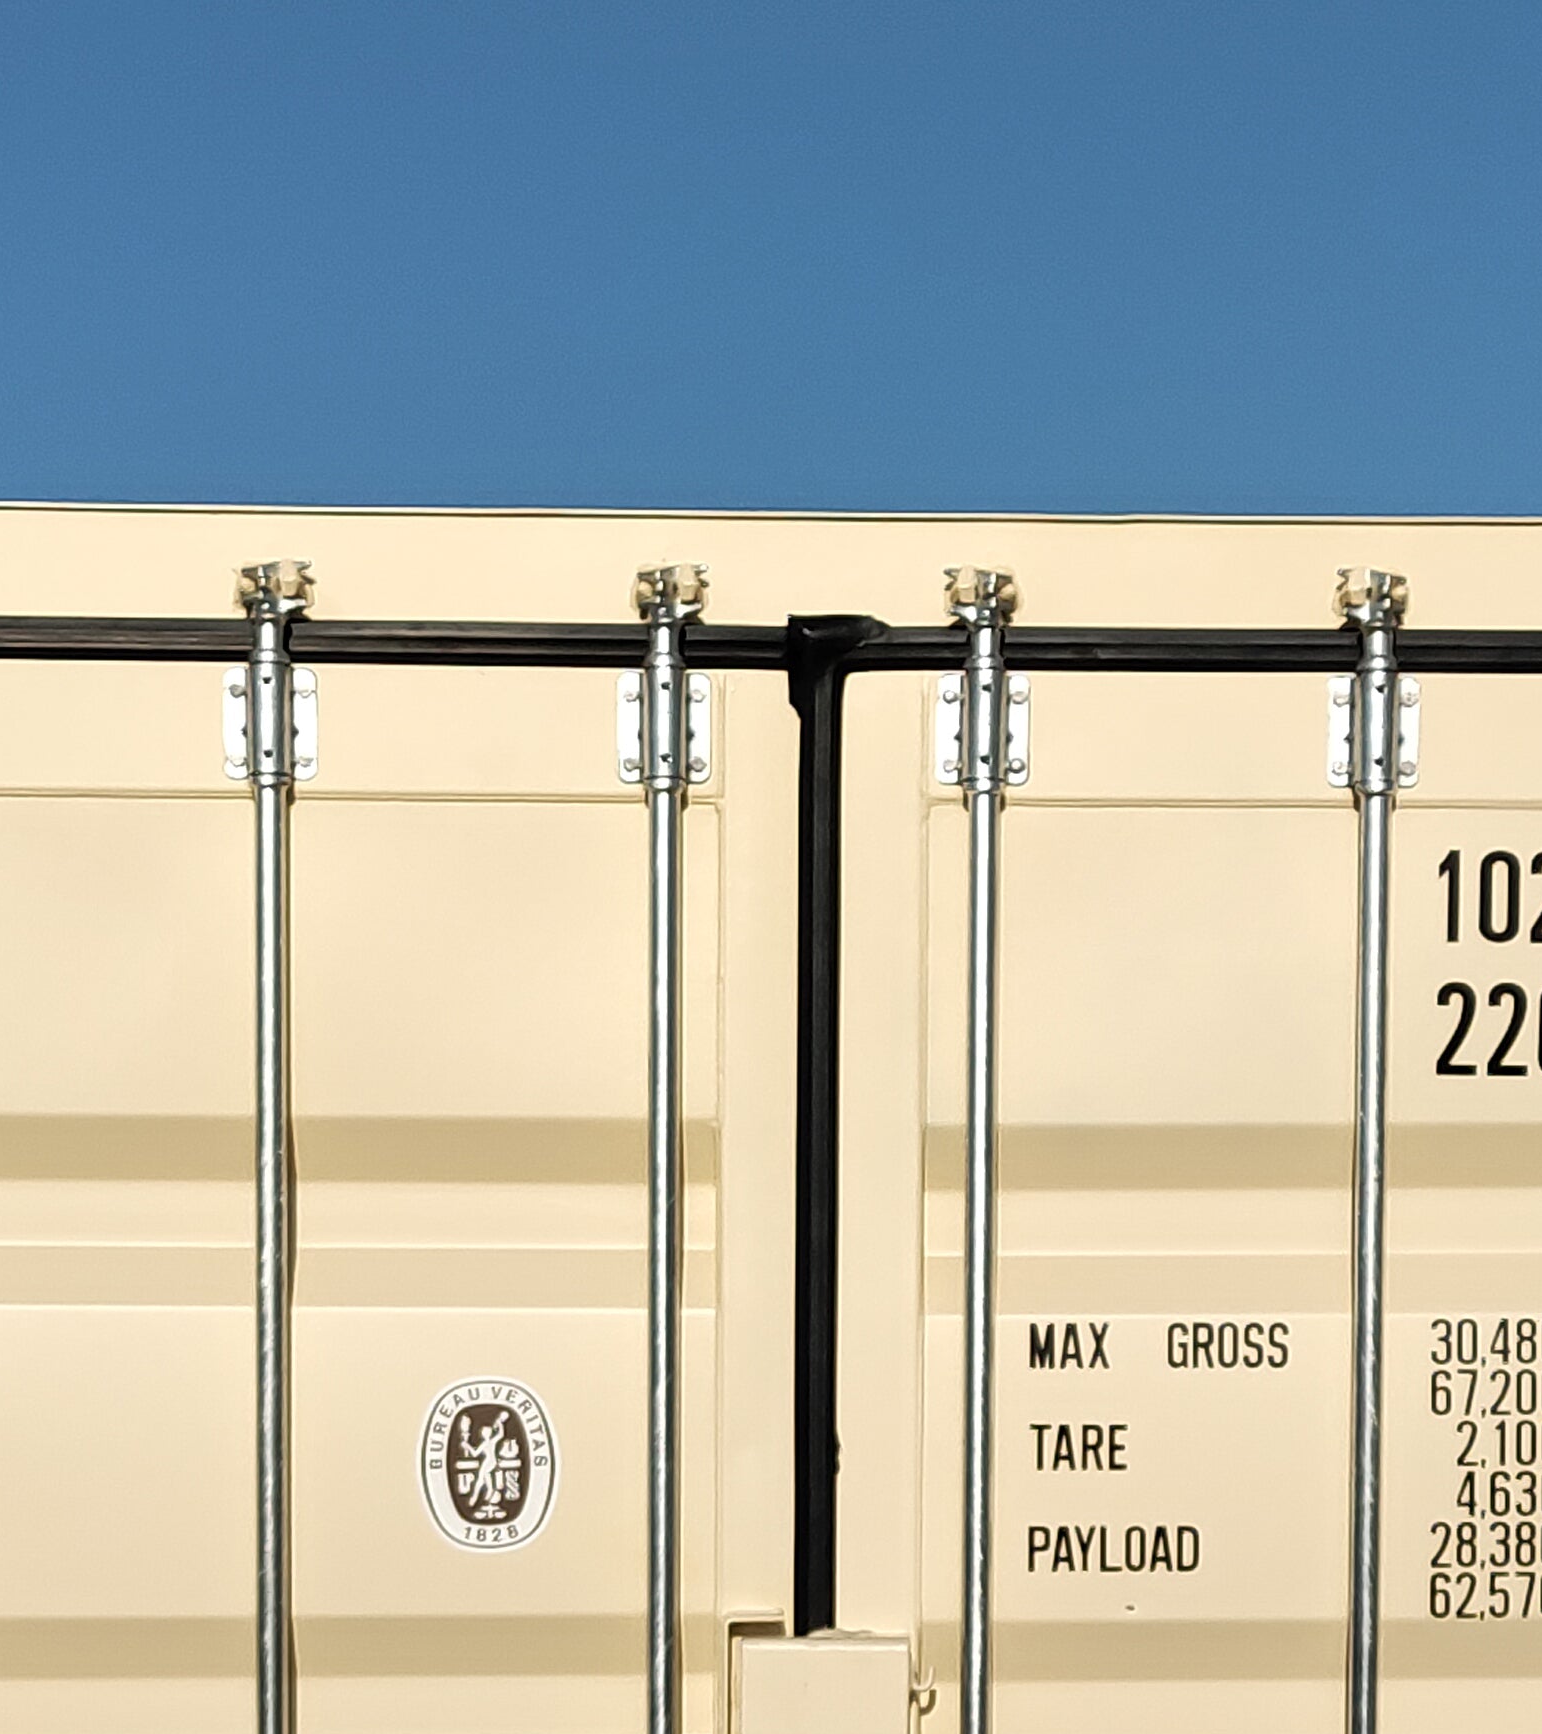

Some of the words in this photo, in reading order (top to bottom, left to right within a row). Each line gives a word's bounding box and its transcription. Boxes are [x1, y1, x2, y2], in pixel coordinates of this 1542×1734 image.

[1028, 1322, 1111, 1370] MAX
[1166, 1321, 1290, 1369] GROSS
[429, 1386, 481, 1470] BUREAU
[491, 1385, 548, 1467] VERITAS
[1029, 1423, 1129, 1472] TARE
[462, 1524, 520, 1543] 1828
[1027, 1525, 1201, 1573] PAYLOAD
